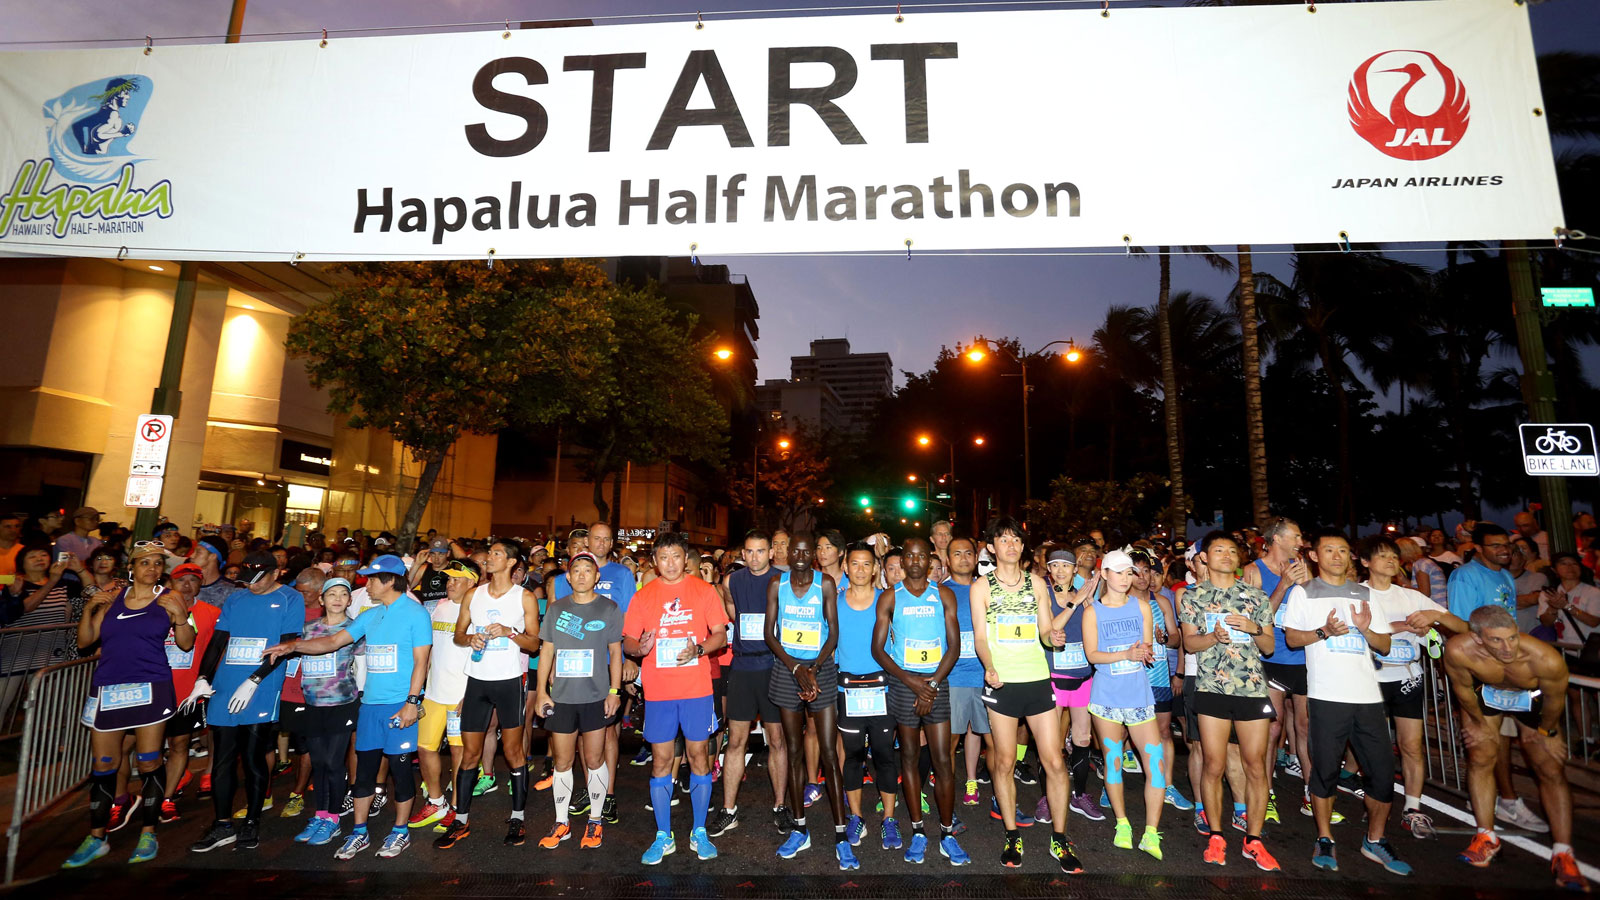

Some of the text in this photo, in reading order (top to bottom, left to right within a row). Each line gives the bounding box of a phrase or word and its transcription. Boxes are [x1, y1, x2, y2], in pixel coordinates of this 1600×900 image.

[465, 42, 958, 157] START
[1385, 128, 1452, 147] JAL
[1332, 176, 1503, 189] JAPAN AIRLINES
[0, 158, 174, 239] Hapalua
[354, 169, 1081, 245] Hapalua Half Marathon
[12, 221, 144, 236] HAWAII'S HALF-MARATHON
[1529, 458, 1594, 470] BIKE LANE
[1015, 626, 1021, 637] 4
[1103, 619, 1140, 637] VICTORIA
[796, 631, 803, 643] 2
[921, 650, 928, 662] 3
[1061, 651, 1083, 662] 4215
[303, 660, 331, 672] 10689
[110, 689, 143, 703] 3483
